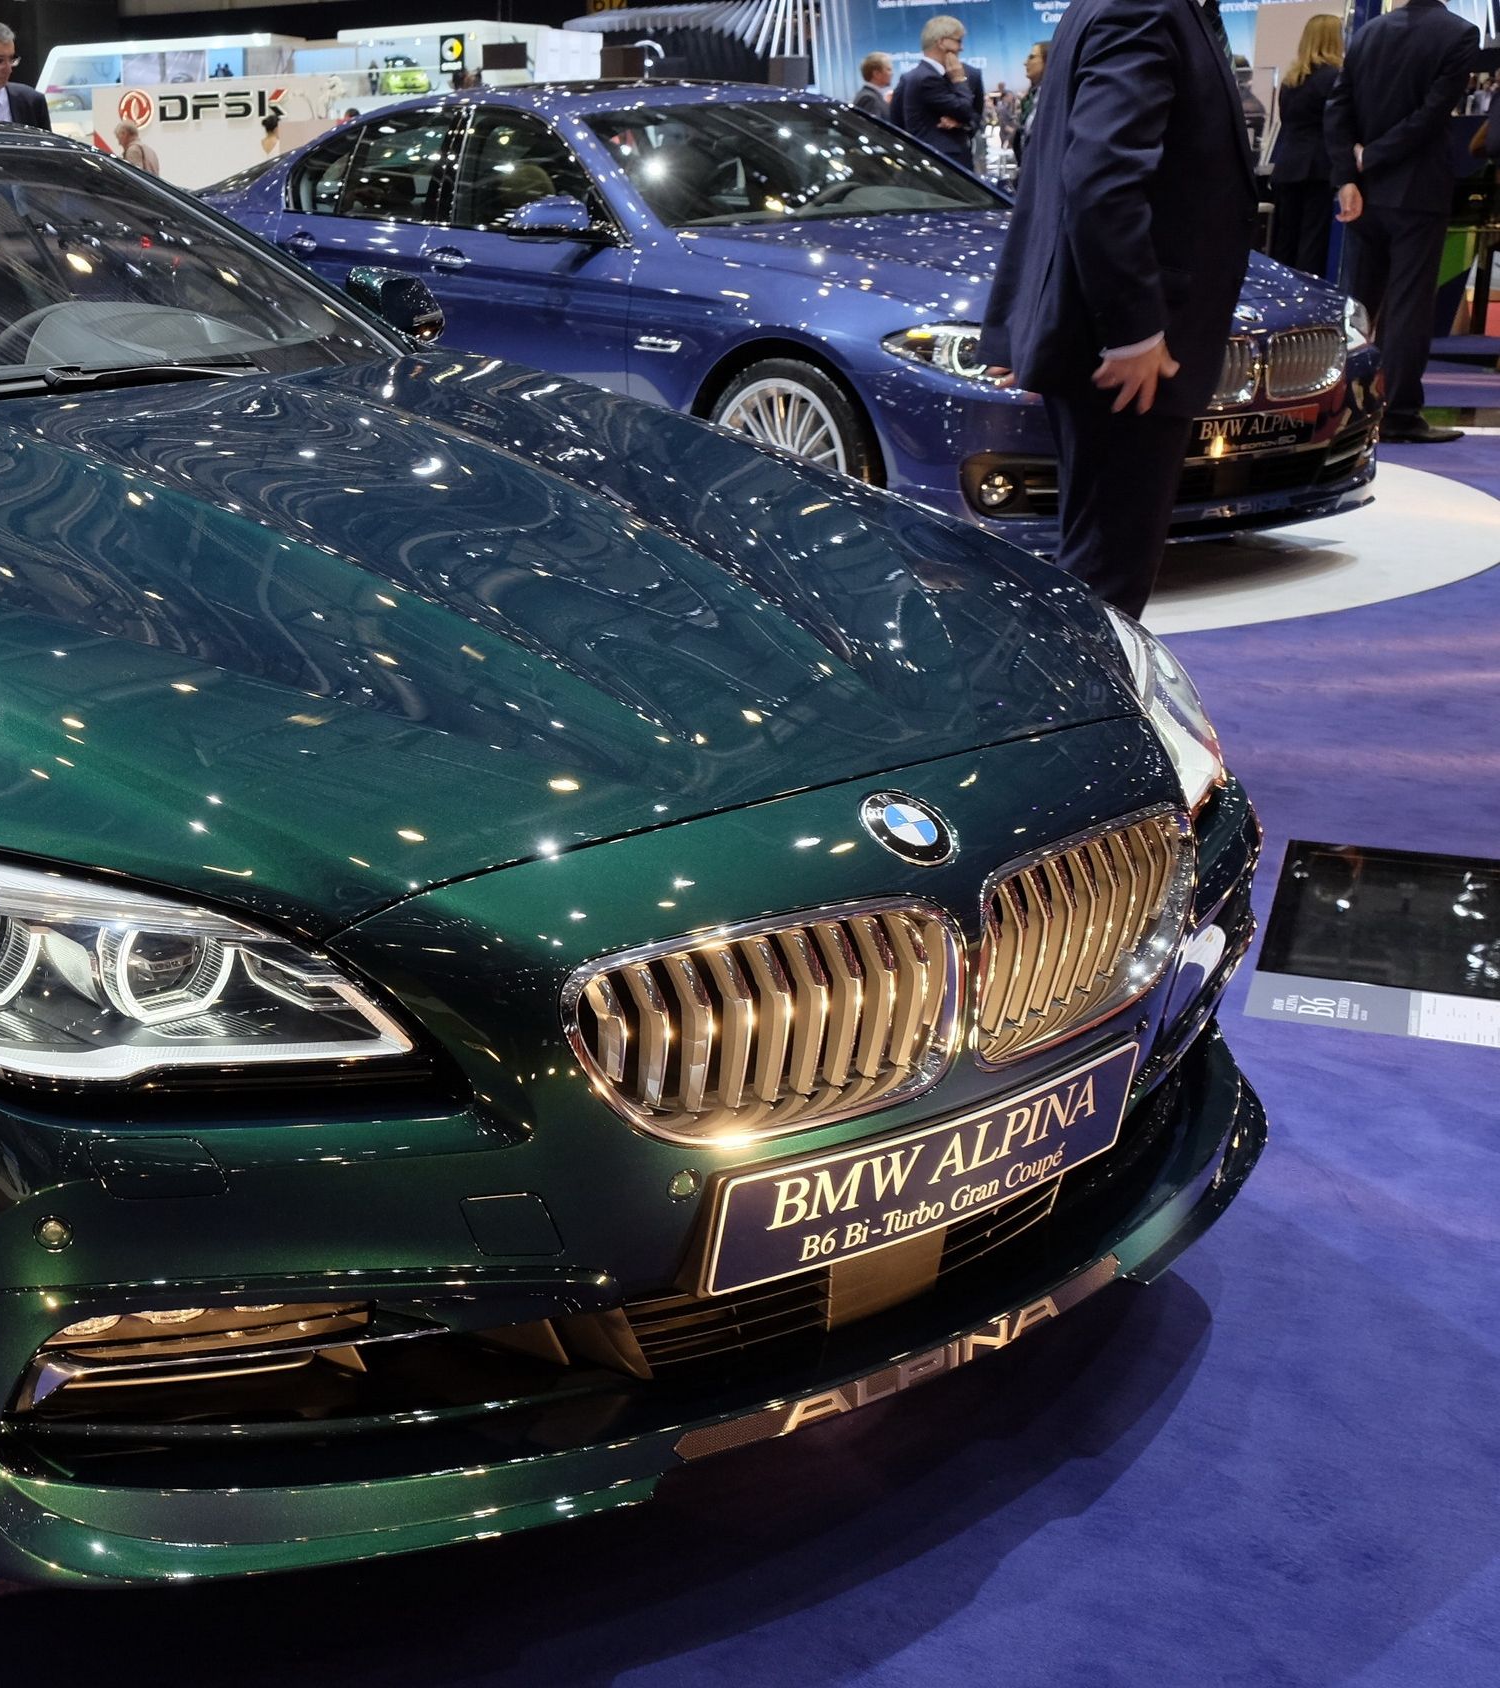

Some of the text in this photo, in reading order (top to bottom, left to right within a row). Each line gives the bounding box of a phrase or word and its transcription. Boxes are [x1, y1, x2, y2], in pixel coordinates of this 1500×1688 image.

[158, 88, 289, 123] DFSK
[1199, 411, 1306, 441] BMW ALPINA
[1298, 994, 1337, 1019] B6
[765, 1074, 1097, 1231] BMW ALPINA
[798, 1227, 838, 1262] B6
[950, 1178, 1000, 1213] Gran
[1005, 1141, 1067, 1189] Coupé
[781, 1295, 1061, 1433] ALPINA
